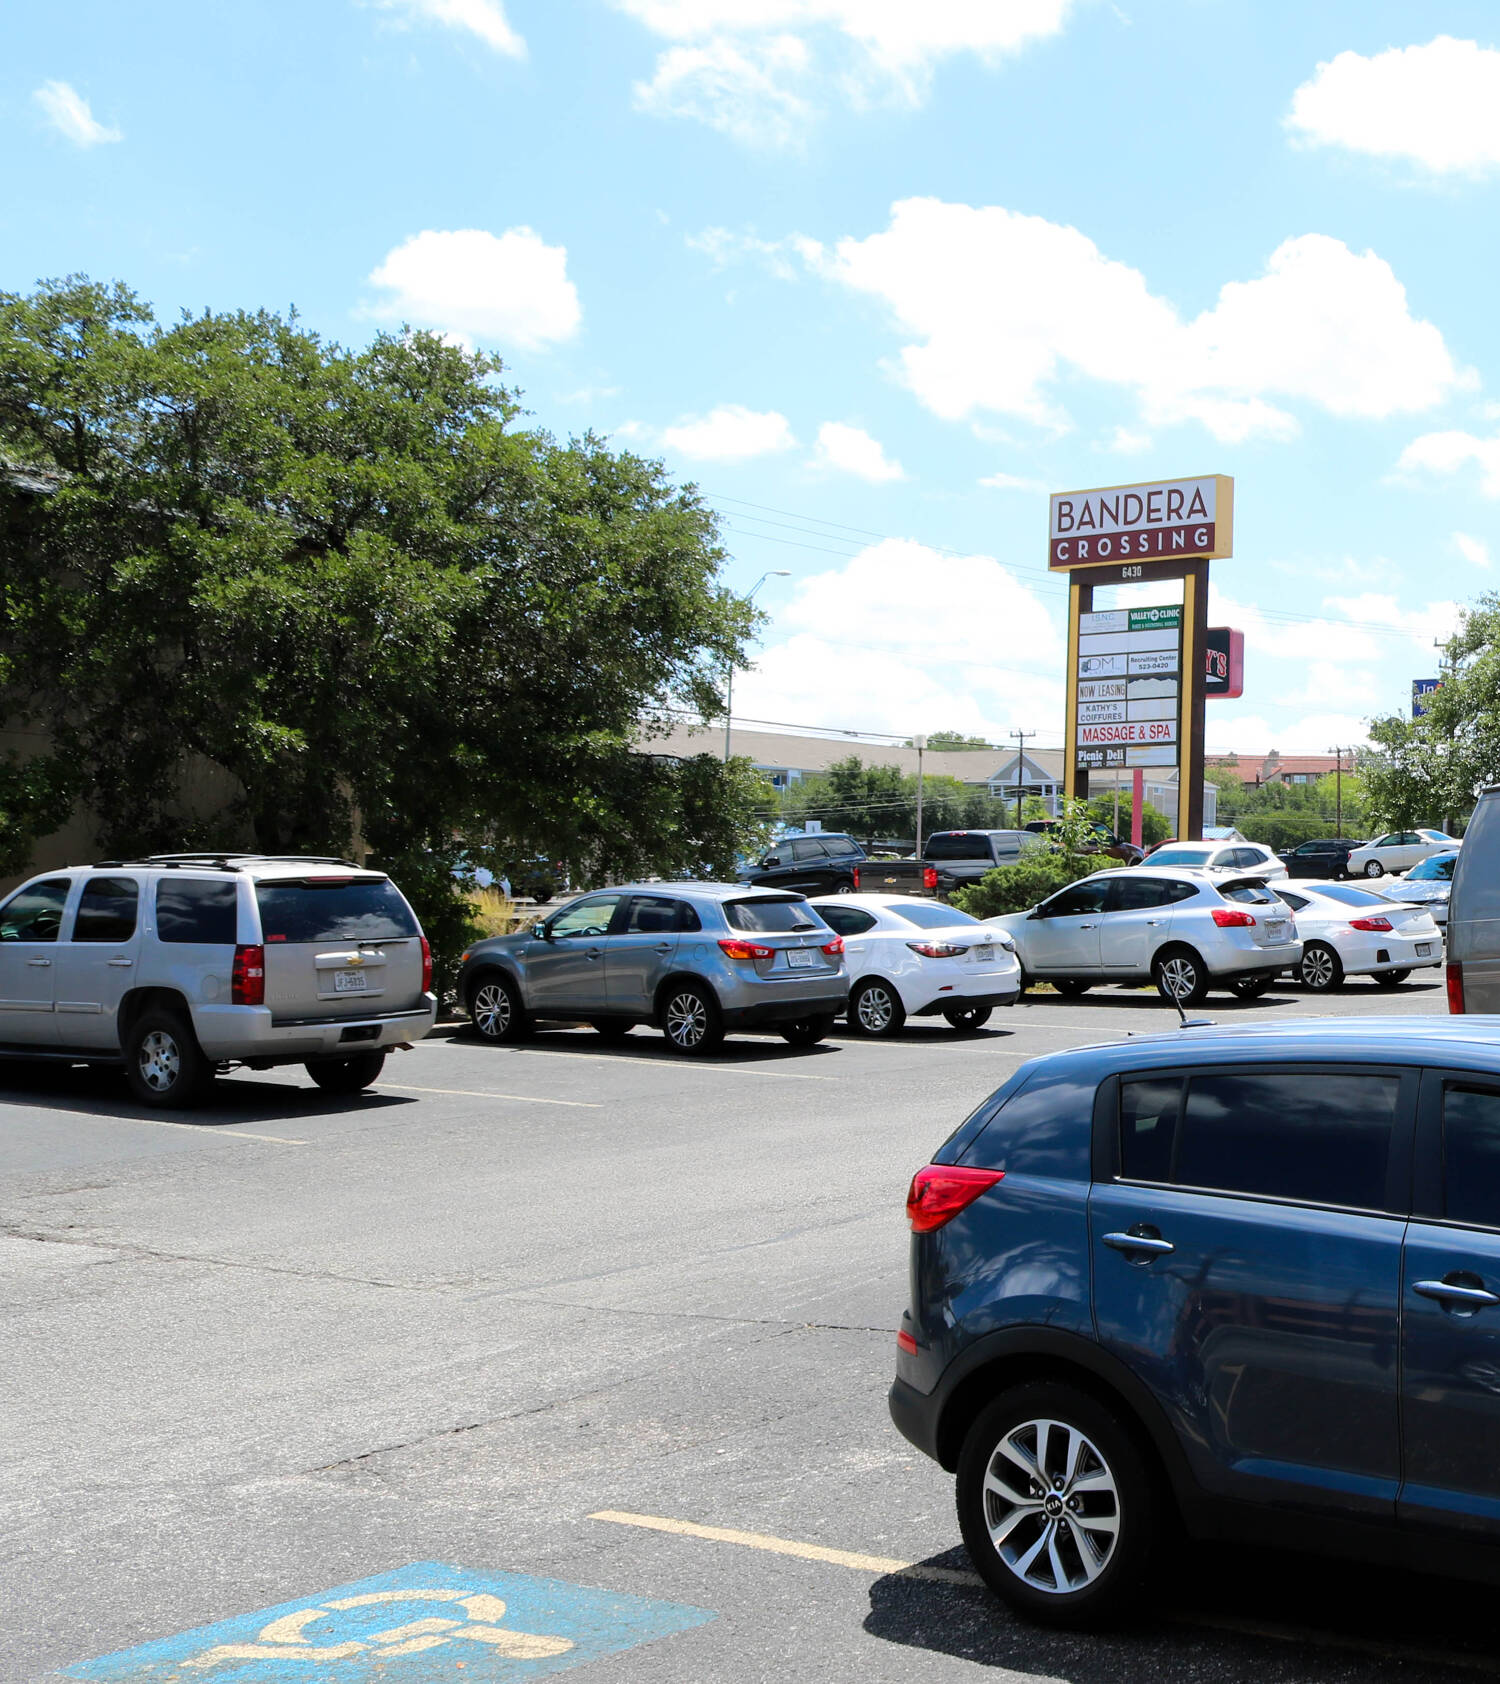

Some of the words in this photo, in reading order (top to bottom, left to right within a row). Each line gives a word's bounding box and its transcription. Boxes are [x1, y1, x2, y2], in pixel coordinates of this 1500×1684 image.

[1057, 486, 1208, 533] BANDERA
[1056, 527, 1208, 561] CROSSING
[1122, 565, 1142, 578] 6430
[1130, 611, 1151, 621] VALLEY
[1159, 608, 1180, 619] CLINIC
[1080, 685, 1096, 698] NOW
[1098, 684, 1125, 697] LEASING
[1085, 704, 1118, 713] KATHY'S
[1080, 713, 1122, 722] COIFFURES
[1082, 725, 1135, 742] MASSAGE
[1138, 725, 1145, 740] &
[1149, 724, 1171, 739] SPA
[1078, 750, 1103, 761] Picnic
[1106, 749, 1124, 760] Deli
[1047, 1500, 1061, 1510] KIA
